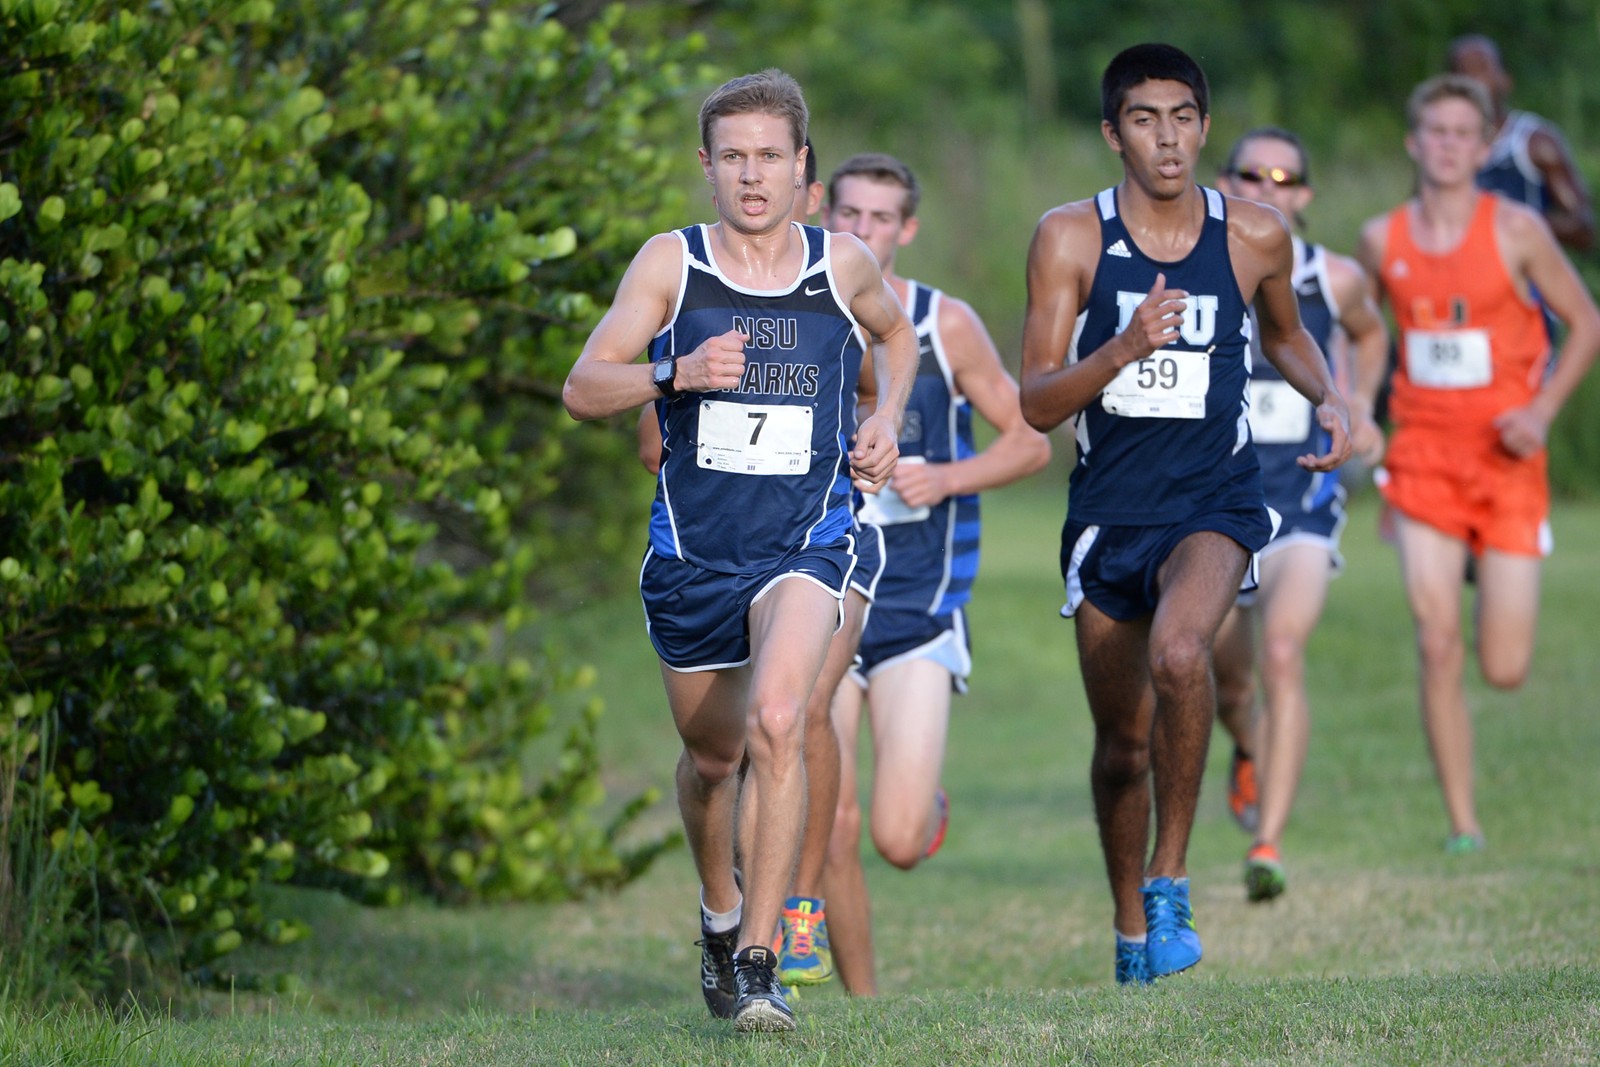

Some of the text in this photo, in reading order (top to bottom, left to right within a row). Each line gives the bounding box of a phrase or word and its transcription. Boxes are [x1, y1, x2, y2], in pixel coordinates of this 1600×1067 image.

[733, 316, 798, 350] NSU
[721, 362, 820, 397] ARKS
[1137, 358, 1178, 389] 59
[747, 412, 768, 446] 7
